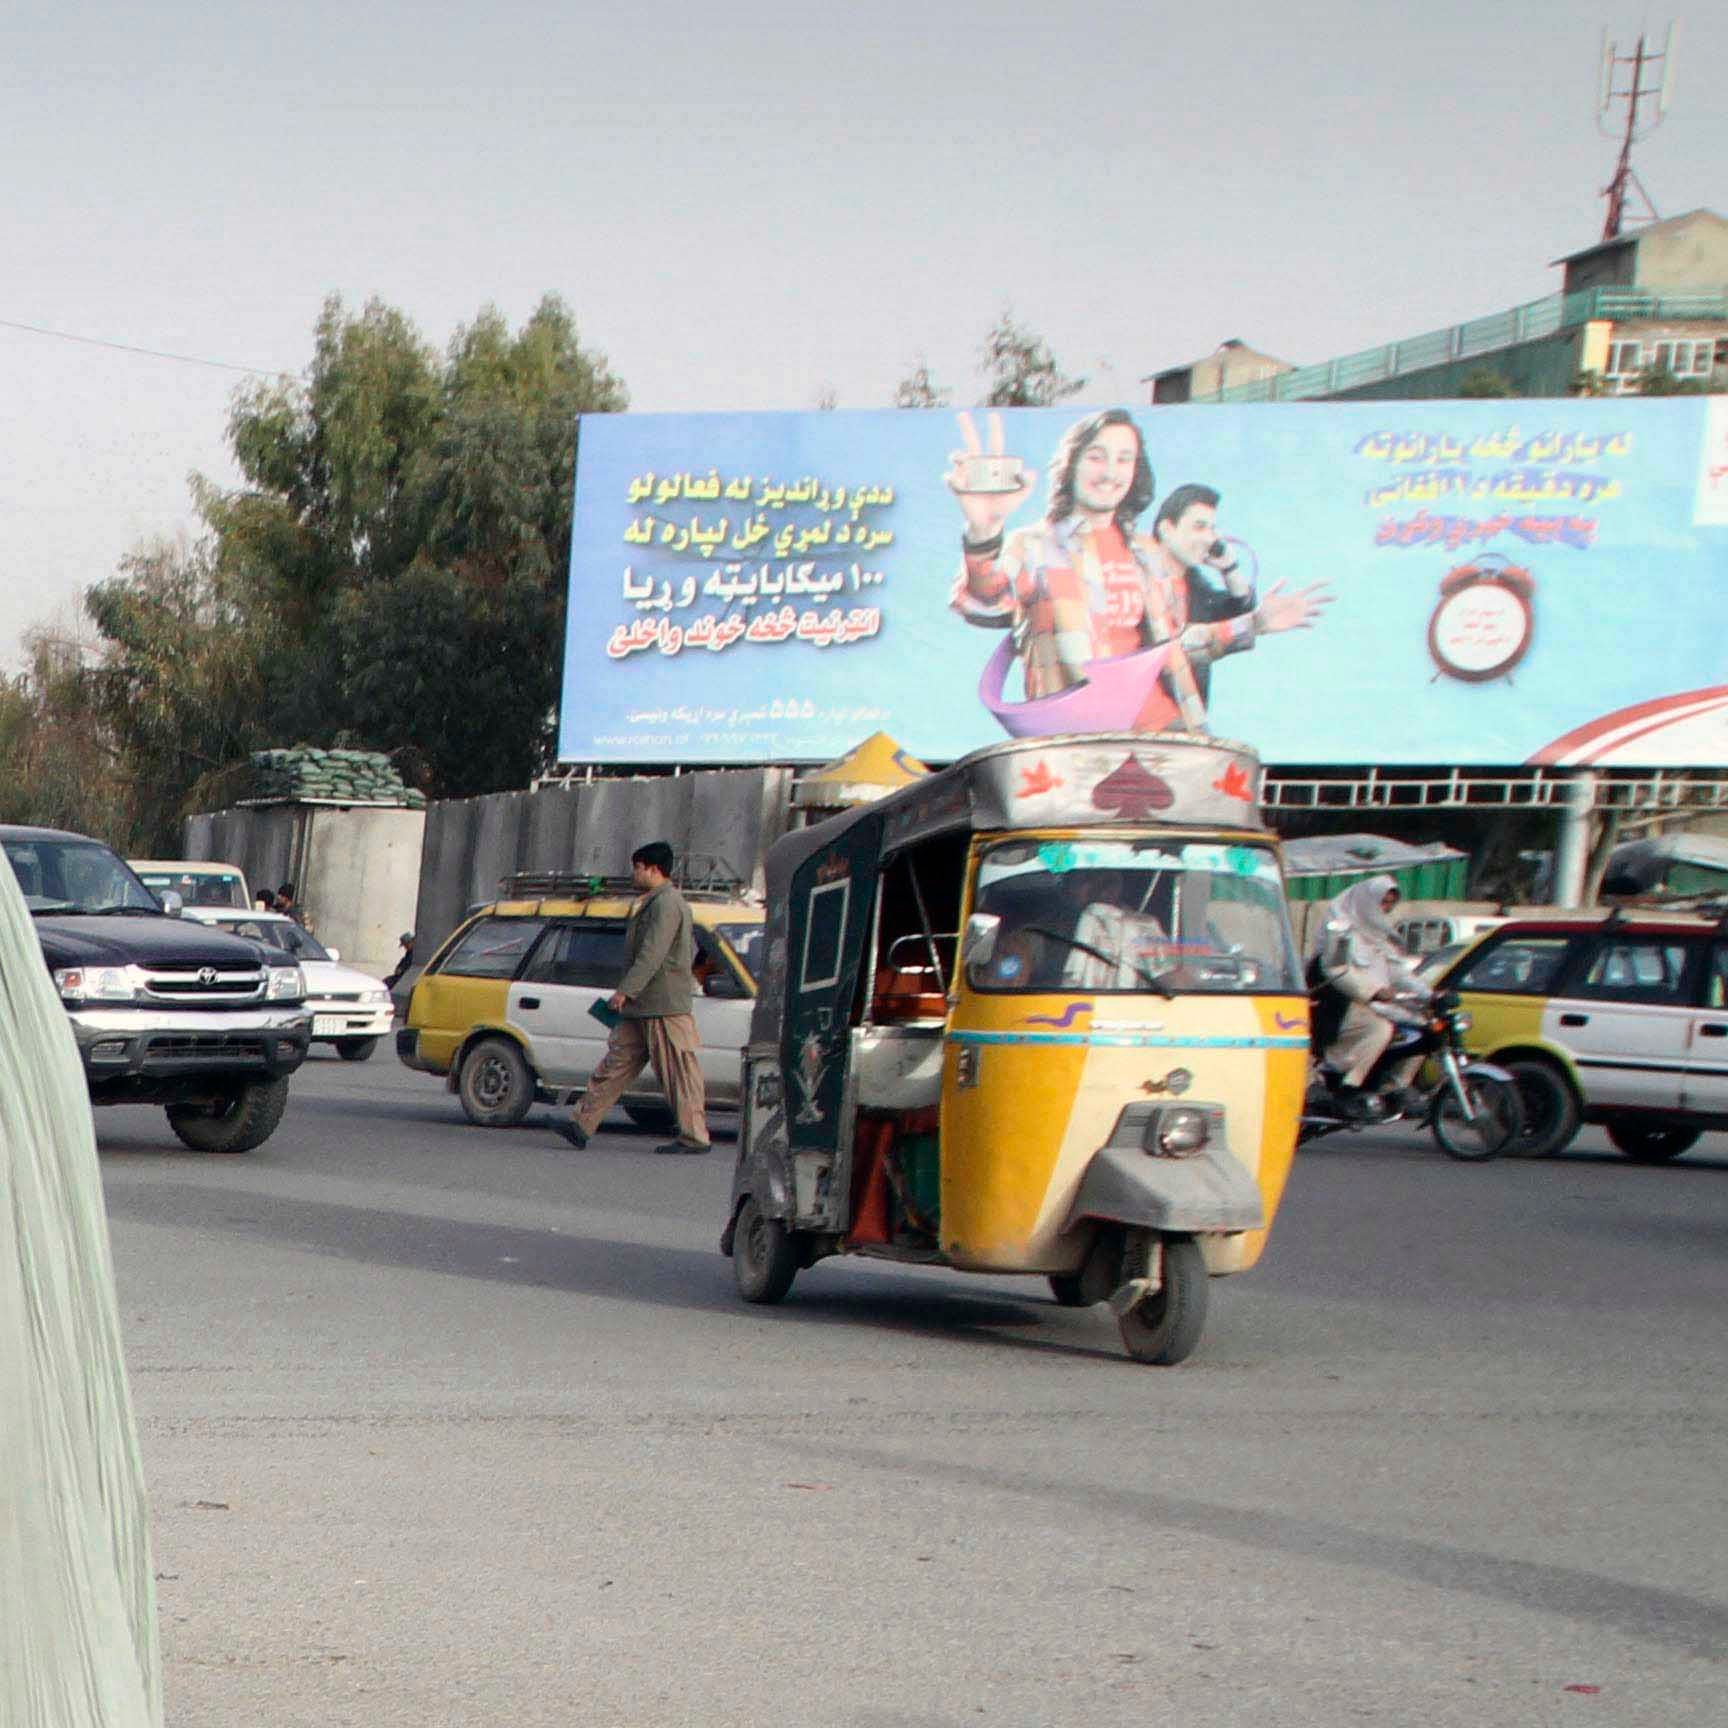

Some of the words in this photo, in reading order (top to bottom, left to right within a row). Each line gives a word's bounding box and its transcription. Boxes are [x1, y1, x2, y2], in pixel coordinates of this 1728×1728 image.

[627, 467, 722, 505] فعالولو
[725, 475, 752, 499] له
[624, 515, 655, 543] له
[661, 516, 729, 557] لپاره
[835, 522, 851, 544] د
[854, 523, 894, 549] سره
